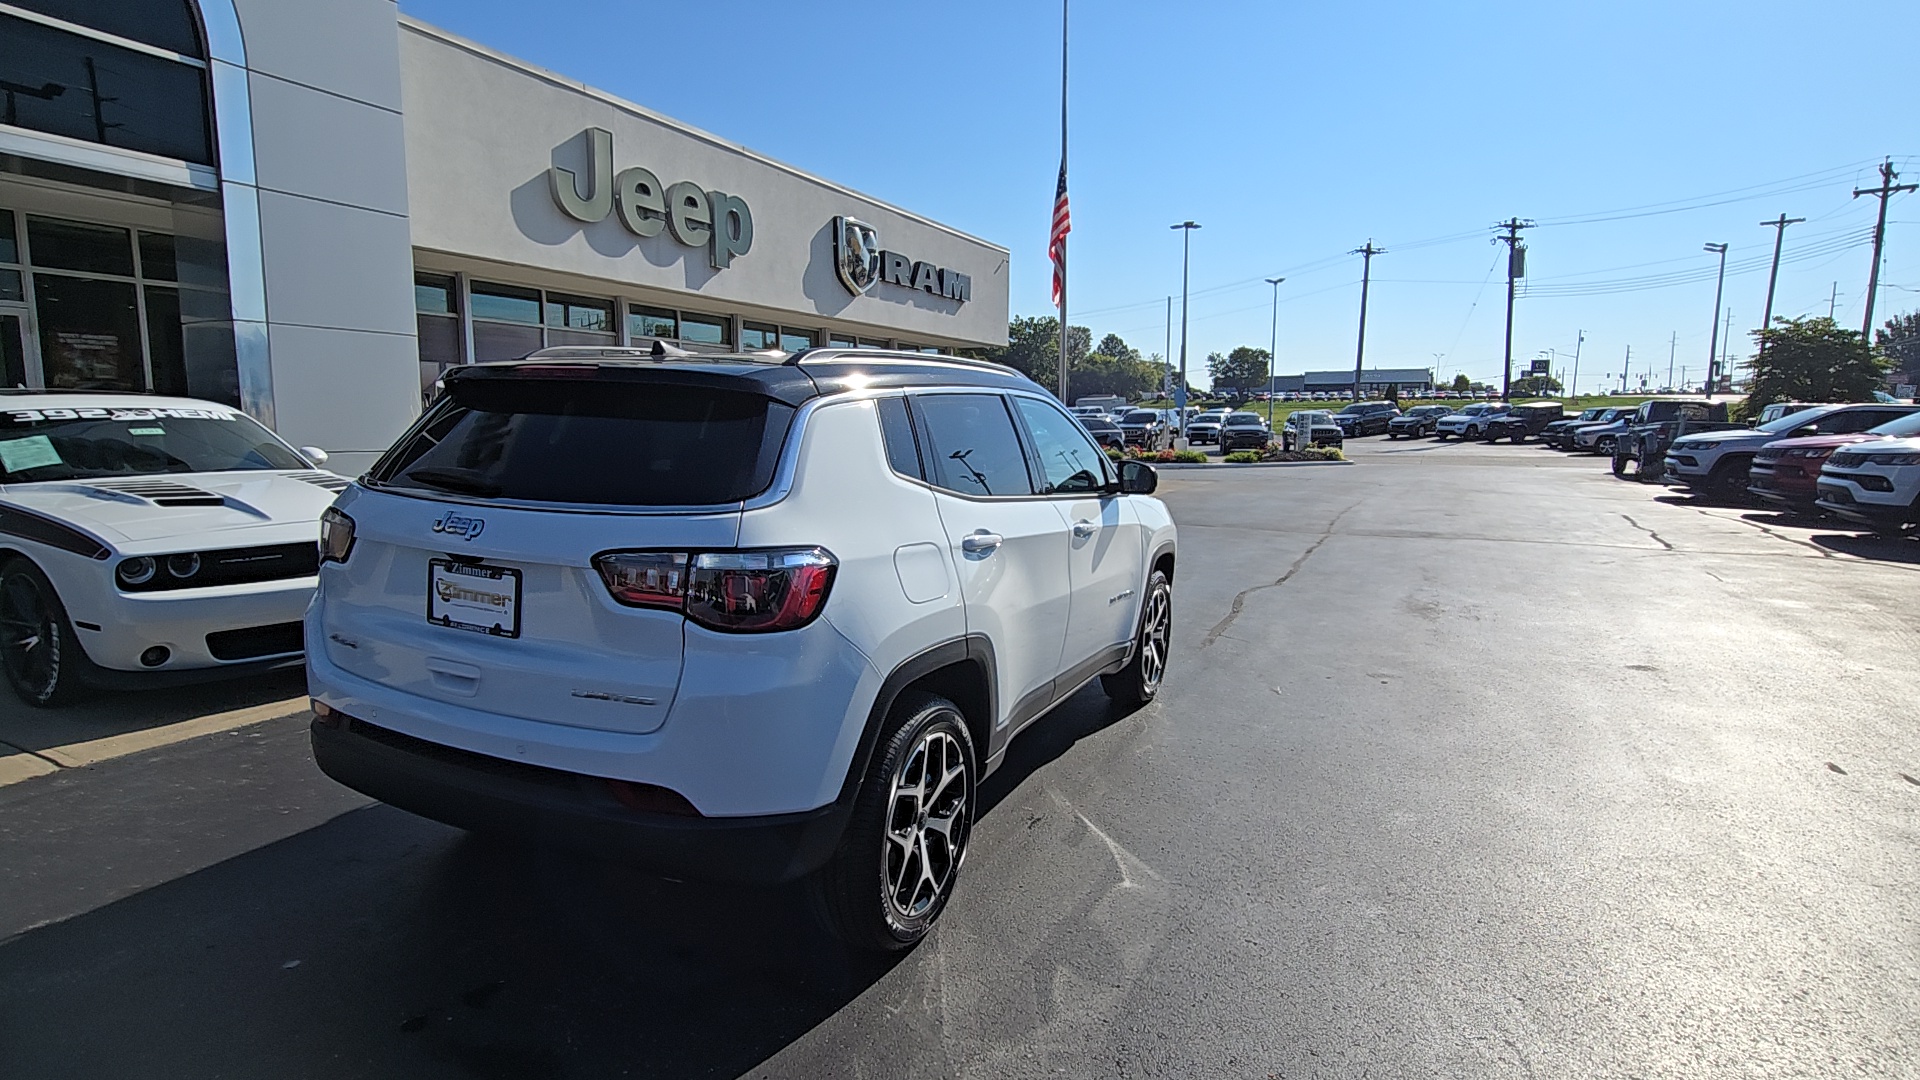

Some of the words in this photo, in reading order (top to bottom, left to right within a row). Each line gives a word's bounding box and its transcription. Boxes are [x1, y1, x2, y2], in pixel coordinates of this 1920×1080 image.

[549, 126, 753, 270] Jeep
[882, 249, 972, 303] RAM
[7, 408, 112, 422] 392
[154, 408, 237, 422] HEMI
[432, 510, 485, 541] Jeep
[451, 562, 493, 578] Zimmer
[438, 579, 512, 608] Zimmer
